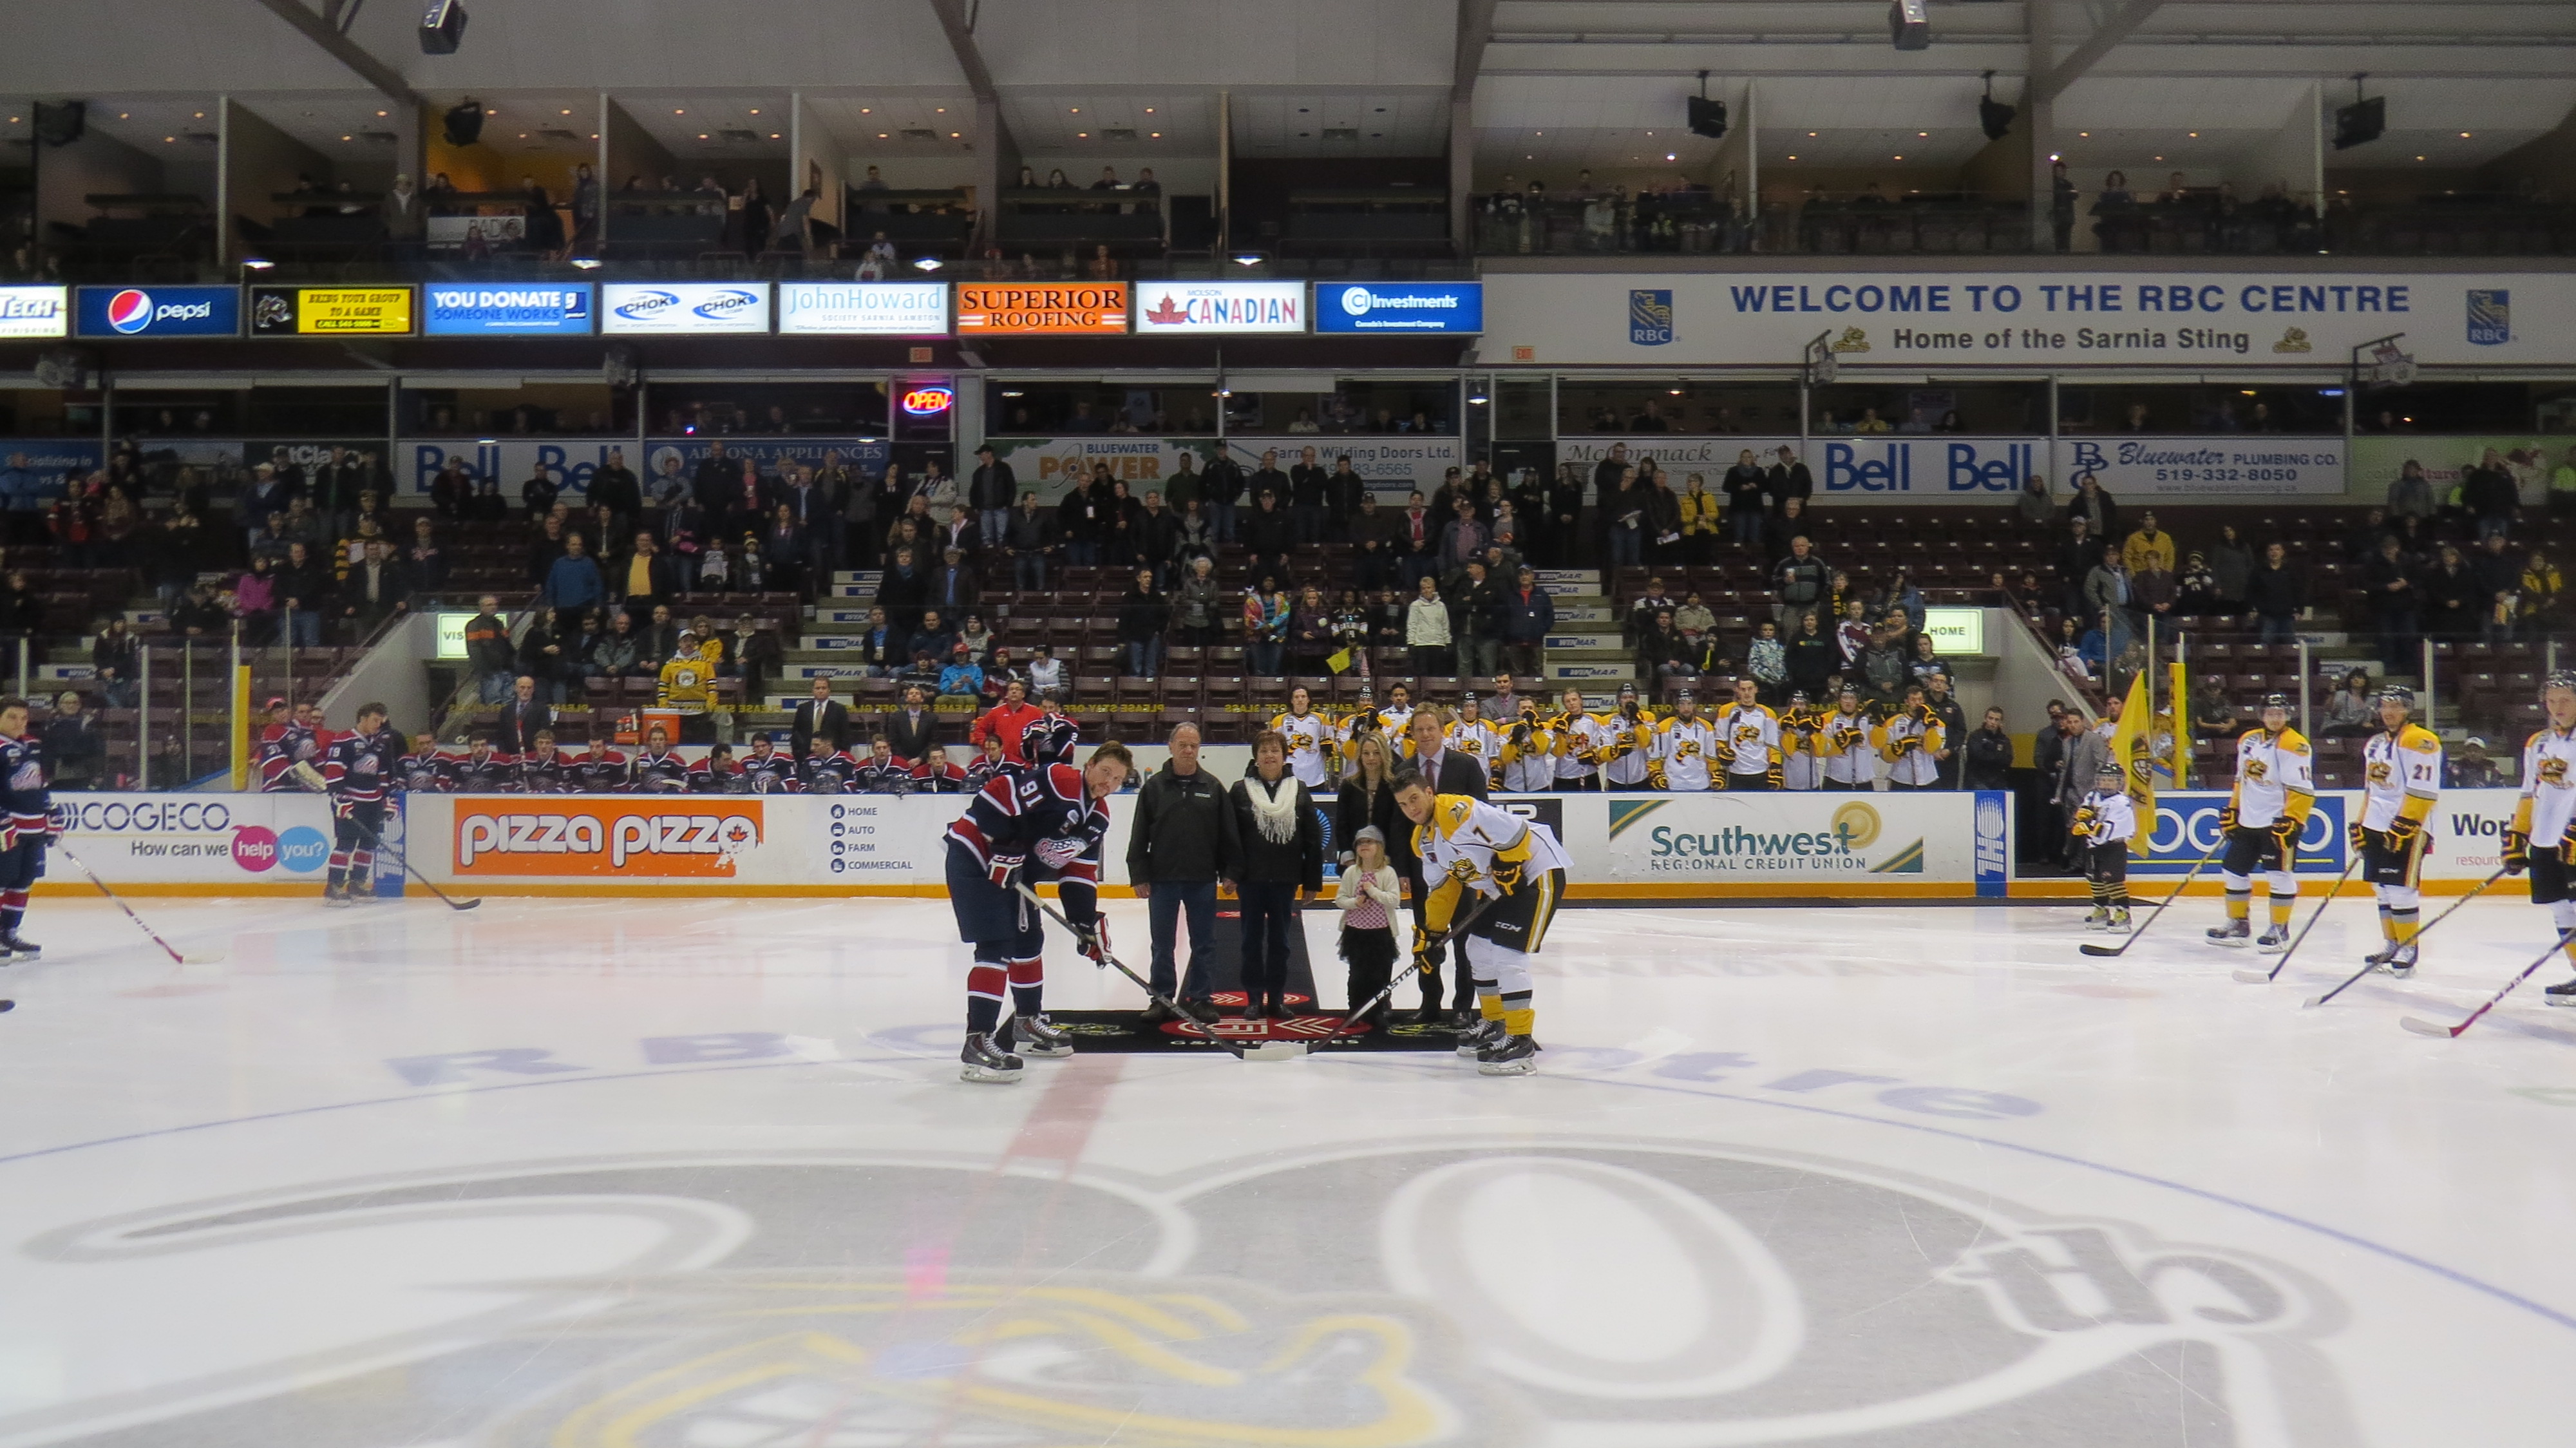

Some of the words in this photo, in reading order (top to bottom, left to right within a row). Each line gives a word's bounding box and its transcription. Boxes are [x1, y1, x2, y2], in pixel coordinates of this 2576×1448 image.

[432, 291, 477, 308] YOU
[478, 291, 562, 308] DONATE
[623, 296, 670, 314] CHOK
[702, 296, 748, 313] CHOK
[962, 290, 1124, 310] SUPERIOR
[1372, 294, 1459, 309] Investments
[1730, 285, 1951, 312] WELCOME
[1965, 285, 2022, 312] TO
[2039, 284, 2123, 312] THE
[2139, 284, 2224, 312] RBC
[2239, 284, 2410, 312] CENTRE
[156, 301, 212, 321] pepsi
[433, 309, 502, 320] SOMEONE
[506, 309, 560, 320] WORKS
[989, 312, 1097, 327] ROOFING
[1186, 298, 1296, 324] CANADIAN
[1633, 329, 1669, 342] RBC
[1893, 328, 1973, 349] Home
[1984, 328, 2012, 349] of
[2022, 328, 2066, 349] the
[2077, 327, 2166, 349] Sarnia
[2177, 327, 2249, 354] Sting
[2471, 329, 2508, 341] RBC
[904, 390, 949, 410] OPEN
[688, 447, 766, 460] ARONA
[1086, 443, 1159, 454] BLUEWATER
[1380, 447, 1422, 459] Doors
[1427, 446, 1455, 459] Ltd.
[1565, 443, 1712, 462] Mcormack
[2117, 442, 2224, 466] Bluewater
[2233, 453, 2310, 466] PLUMBING
[2315, 454, 2340, 466] CO.
[1038, 456, 1160, 480] POWER
[1825, 443, 1910, 491] Bell
[1947, 443, 2031, 491] Bell
[2155, 469, 2298, 482] 519-332-8050
[1929, 627, 1965, 636] HOME
[829, 638, 862, 646] WINMA
[1558, 638, 1597, 647] WINMAR
[2413, 764, 2432, 781] 21
[1019, 779, 1045, 808] 91
[79, 802, 231, 832] COGECO
[848, 807, 878, 816] HOME
[848, 826, 875, 834] AUTO
[1472, 824, 1492, 843] 7
[460, 814, 603, 867] pizza
[612, 814, 759, 868] pizza
[848, 844, 876, 852] FARM
[1651, 822, 1859, 857] Southwest
[131, 841, 166, 857] How
[171, 845, 201, 856] can
[205, 845, 229, 856] we
[238, 841, 274, 861] help
[281, 841, 323, 862] you?
[848, 861, 913, 870] COMMERCIAL
[1651, 857, 1738, 870] REGIONAL
[1744, 857, 1804, 870] CREDIT
[1811, 857, 1866, 870] UNION
[1494, 920, 1522, 932] CCM
